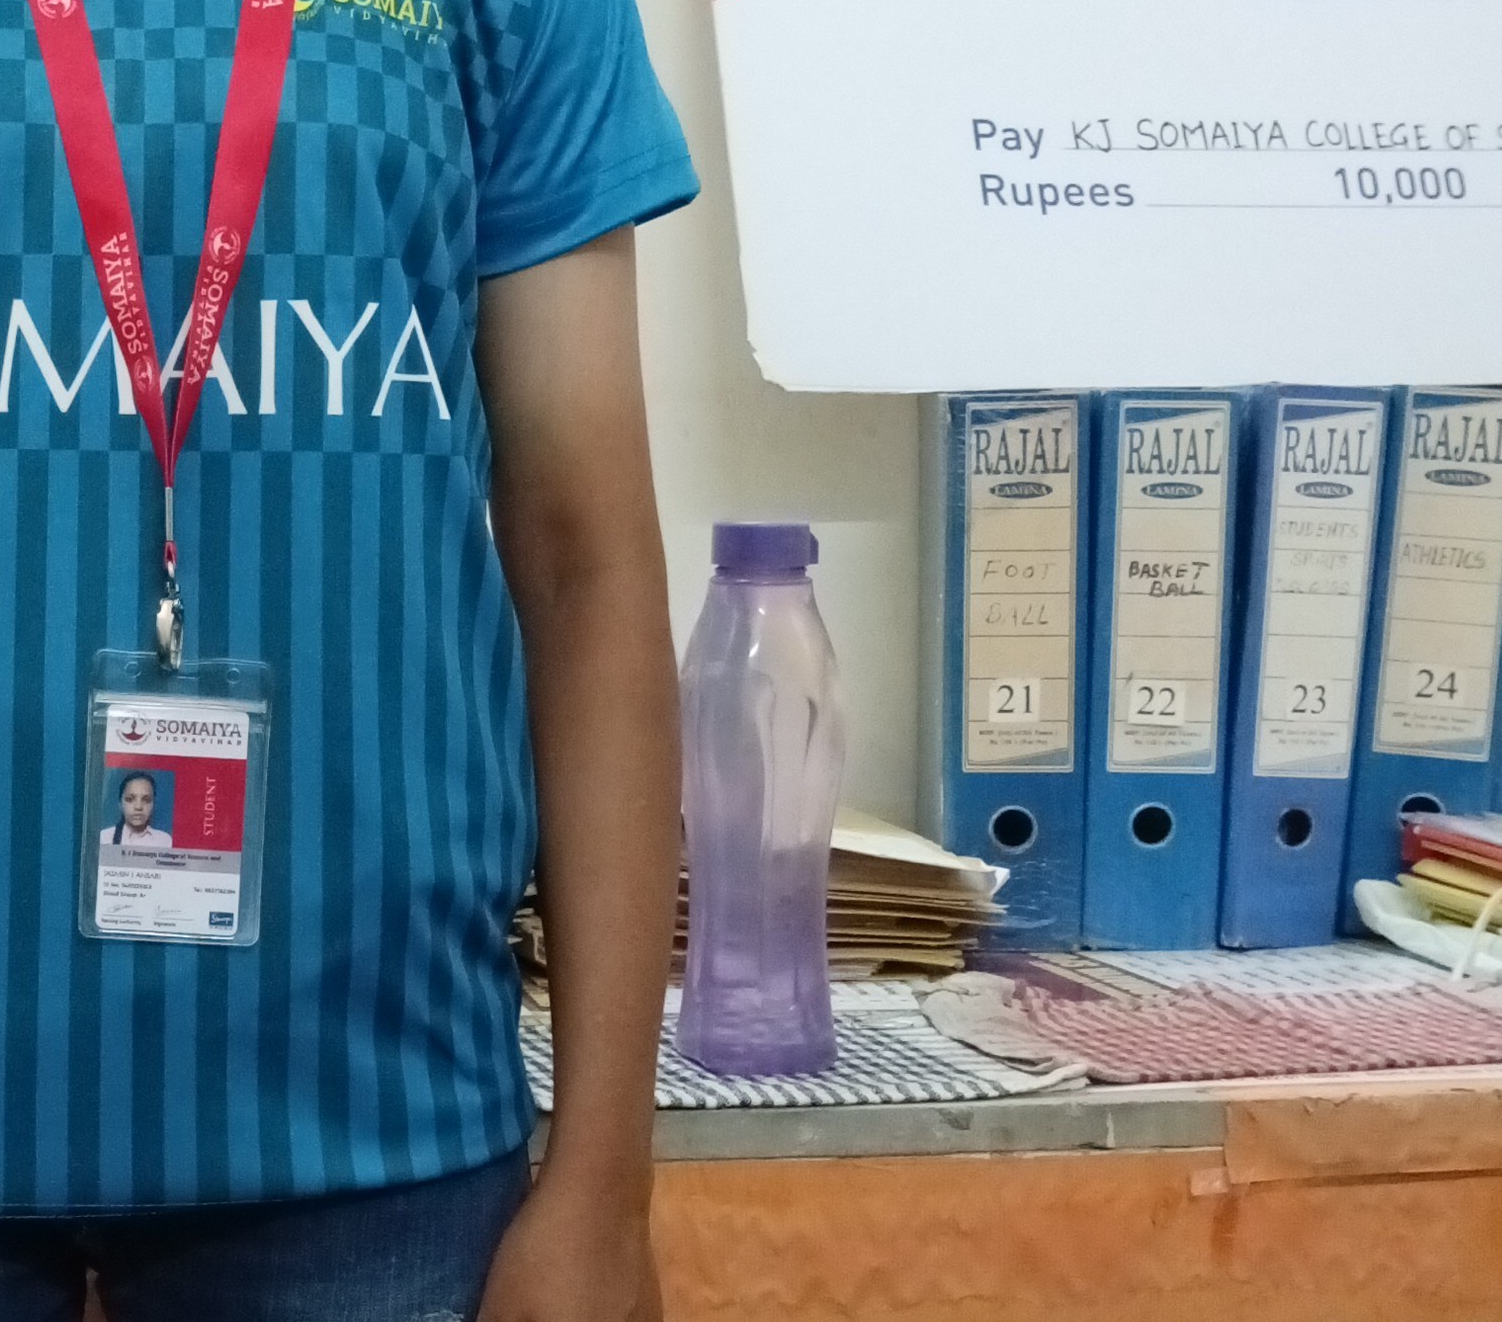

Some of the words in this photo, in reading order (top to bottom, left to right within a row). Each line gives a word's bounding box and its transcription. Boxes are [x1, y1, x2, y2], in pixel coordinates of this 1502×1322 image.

[971, 118, 1045, 158] Pay
[1071, 118, 1113, 153] KJ
[1137, 118, 1289, 151] SOMAIYA
[1305, 120, 1432, 150] COLLEGE
[1445, 124, 1481, 150] OF
[979, 174, 1136, 214] Rupees
[1333, 167, 1467, 204] 10,000
[101, 234, 143, 356] SOMAIYA
[973, 428, 1070, 475] RAJAL
[1125, 428, 1223, 475] RAJAL
[1281, 426, 1372, 476] RAJAL
[982, 559, 1057, 582] FOOT
[1127, 560, 1211, 580] BASKET
[1401, 542, 1486, 570] ATHLETICS
[1149, 580, 1205, 598] BALL
[985, 602, 1050, 628] BALL
[996, 683, 1033, 715] 21
[1290, 684, 1328, 715] 23
[1415, 669, 1460, 701] 24
[1136, 686, 1178, 717] 22
[156, 719, 243, 738] SOMAIYA
[203, 776, 217, 837] STUDENT
